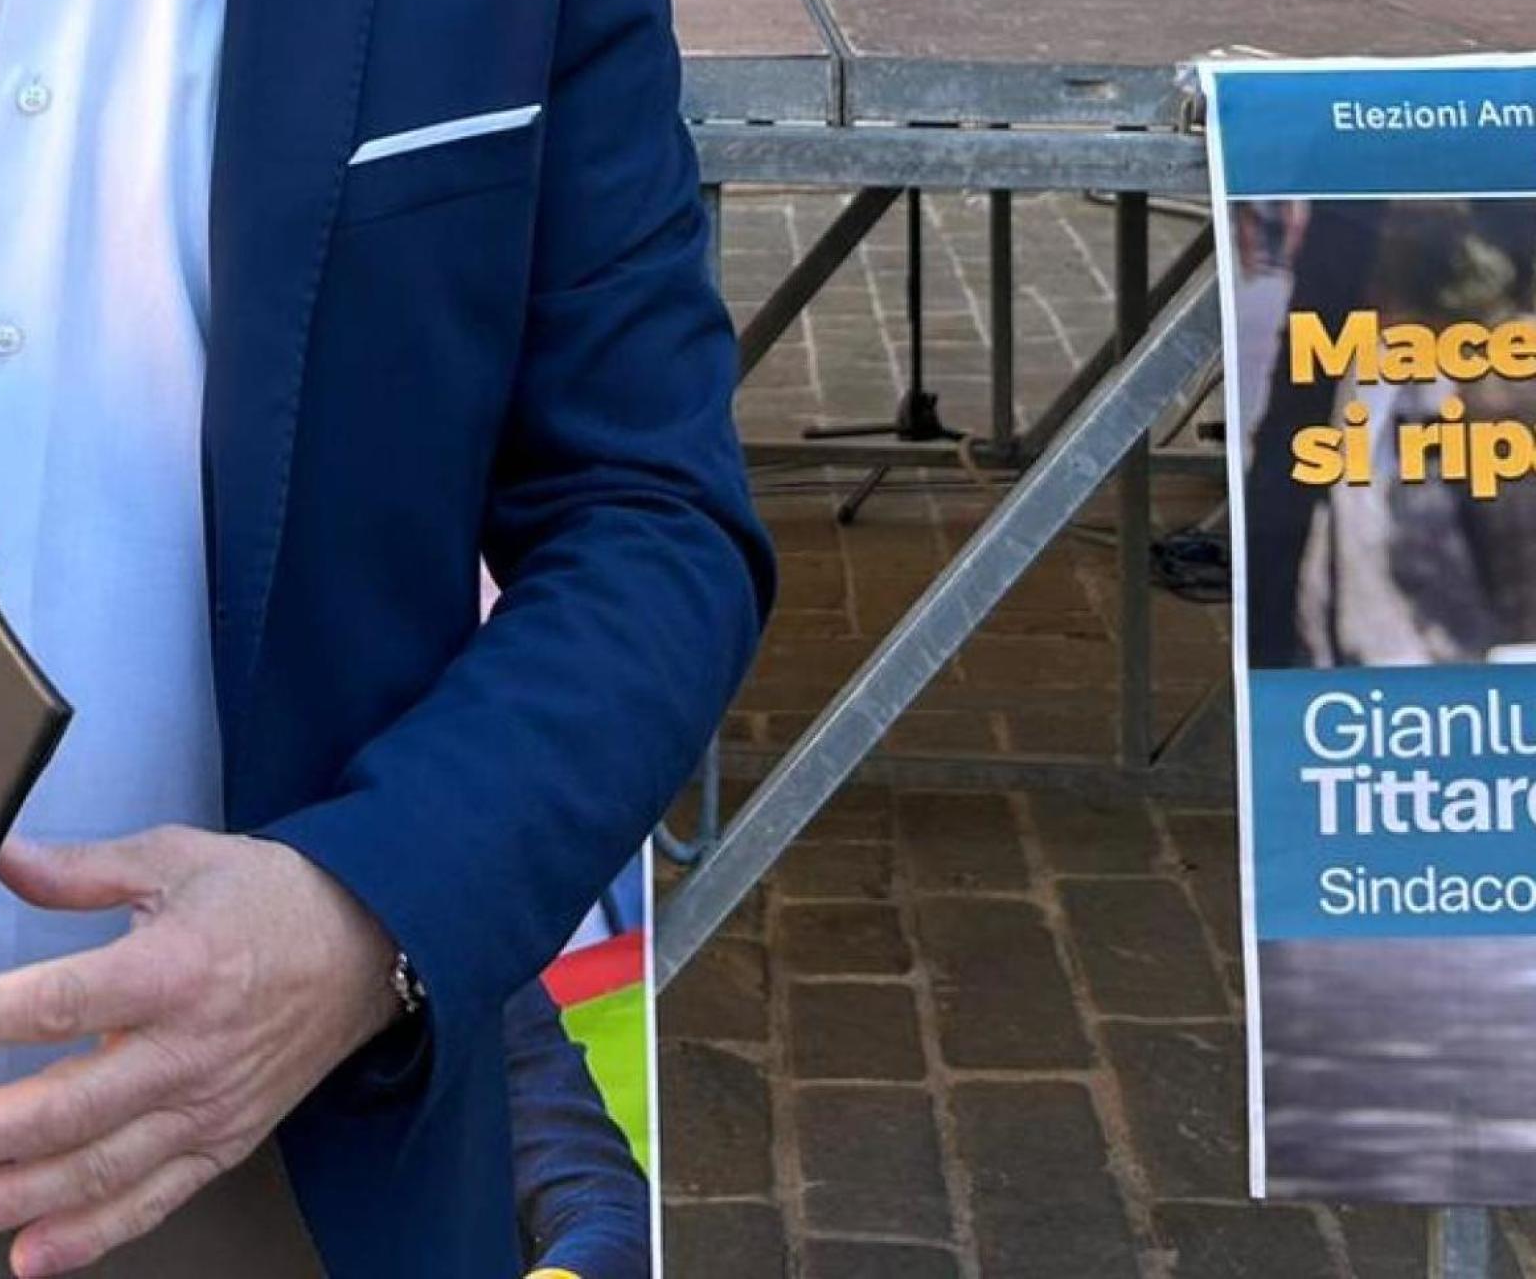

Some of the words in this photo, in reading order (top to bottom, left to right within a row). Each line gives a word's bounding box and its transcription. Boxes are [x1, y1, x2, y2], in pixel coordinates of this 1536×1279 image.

[1331, 100, 1468, 130] Elezioni
[1477, 99, 1534, 129] Am
[1287, 309, 1536, 386] Mace
[1289, 397, 1371, 487] si
[1299, 763, 1536, 837] Tittar
[1319, 864, 1536, 916] Sindaco
